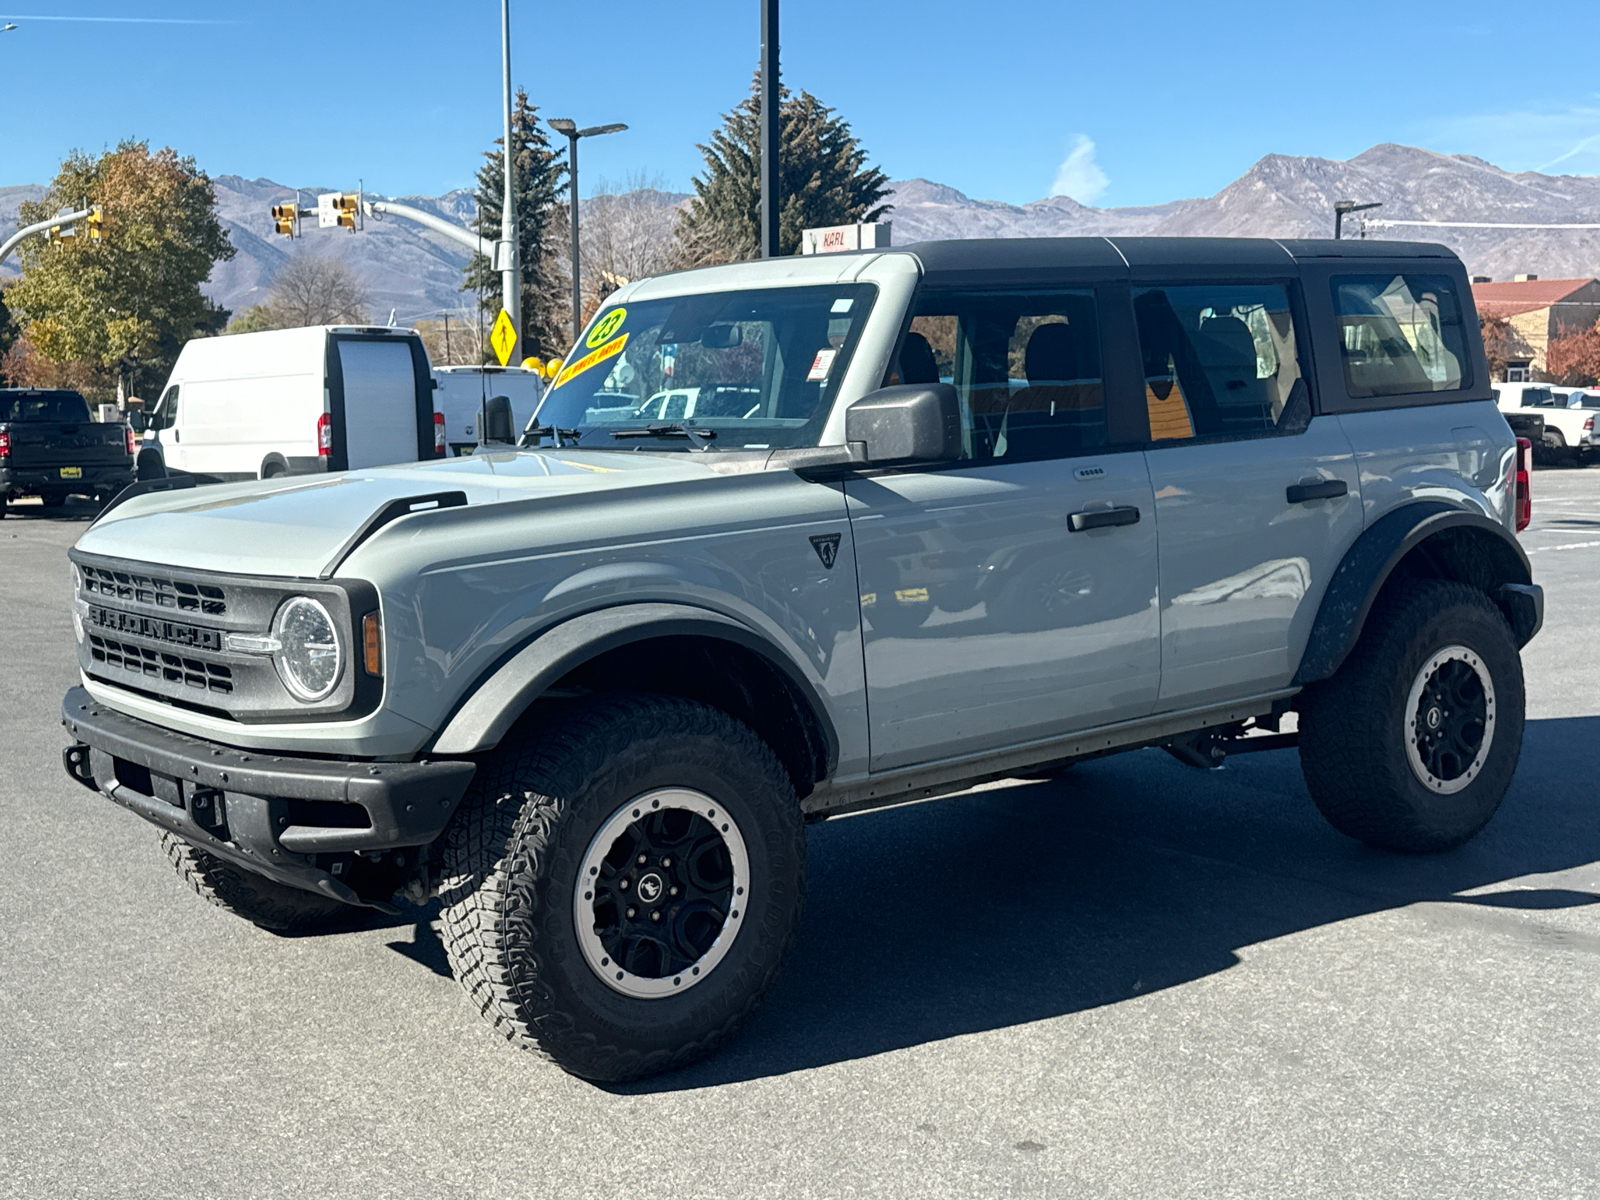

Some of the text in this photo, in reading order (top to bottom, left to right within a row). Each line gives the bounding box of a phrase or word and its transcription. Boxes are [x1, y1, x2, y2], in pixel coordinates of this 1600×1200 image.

[823, 231, 845, 247] KARL
[591, 313, 621, 343] 23
[88, 605, 222, 652] BRONCO
